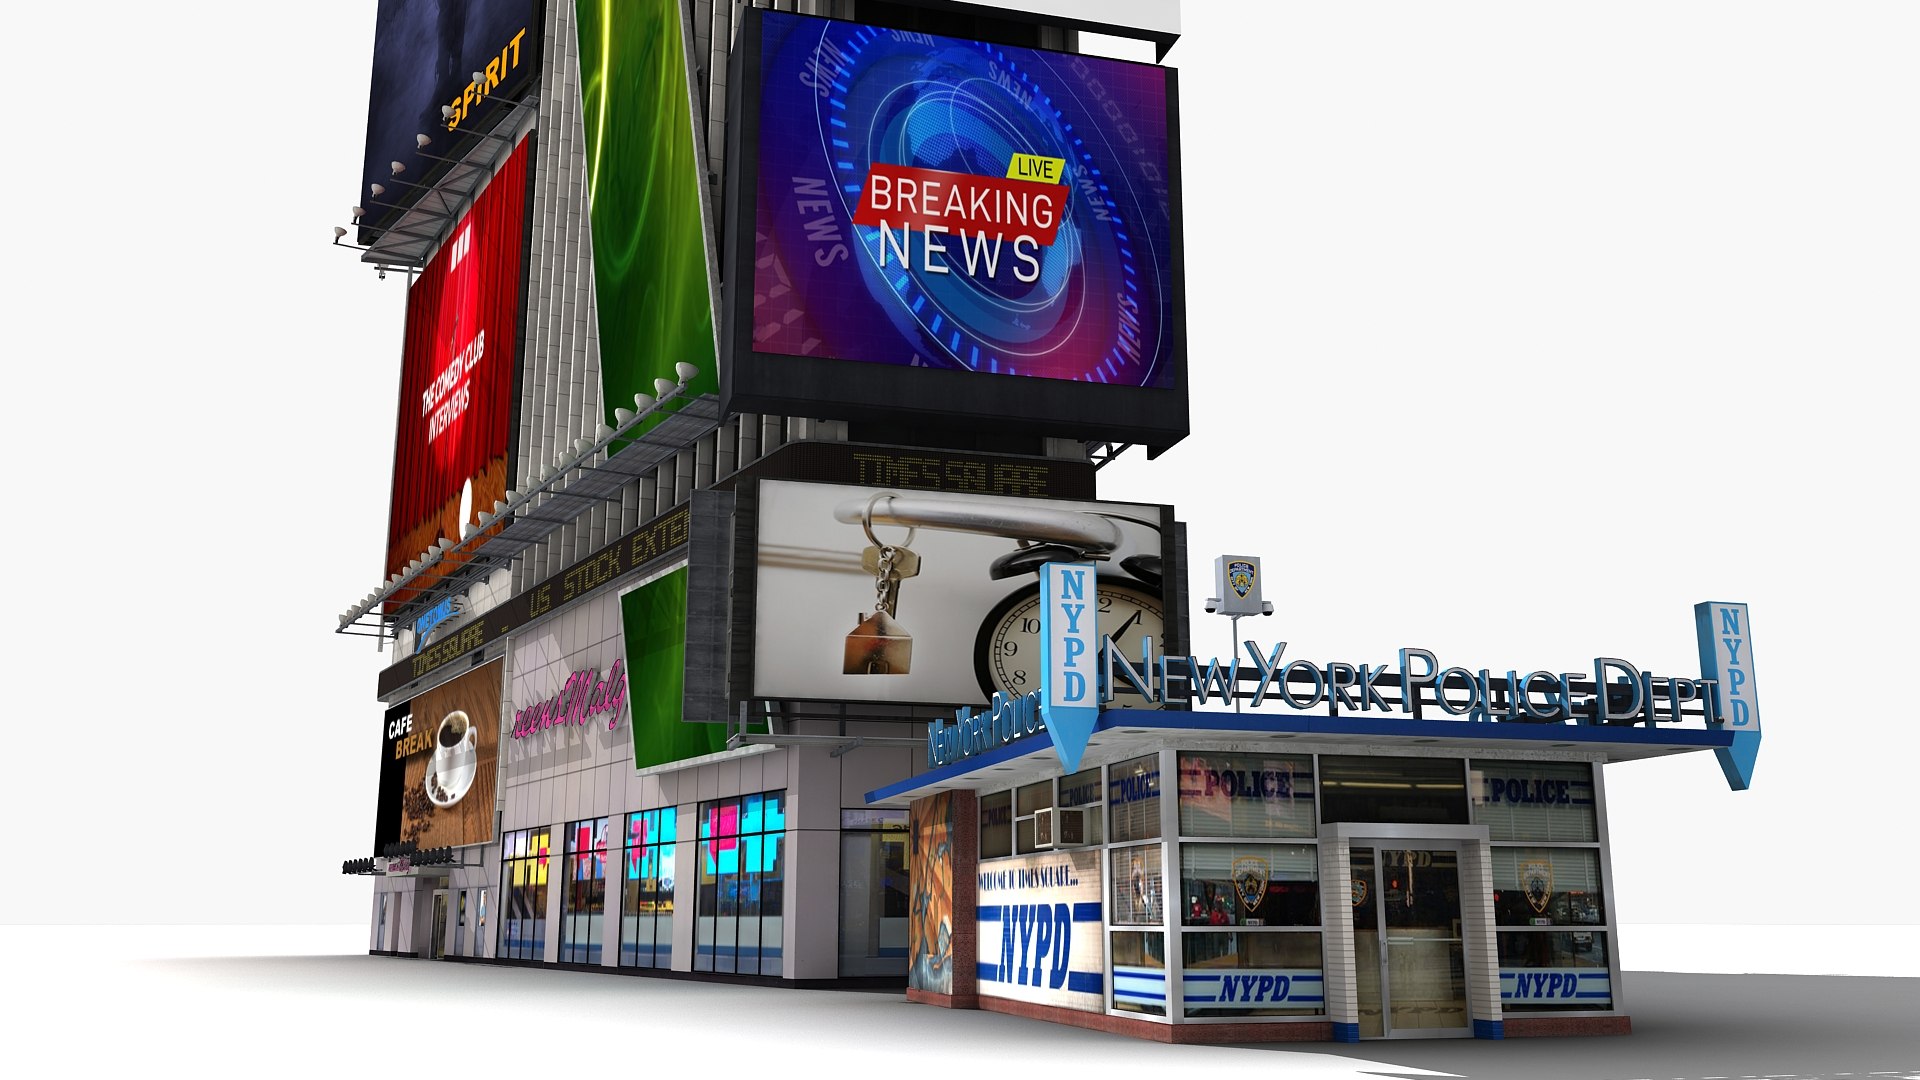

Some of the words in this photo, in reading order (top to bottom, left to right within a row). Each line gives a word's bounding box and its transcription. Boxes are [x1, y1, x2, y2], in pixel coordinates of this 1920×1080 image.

[448, 27, 526, 132] SPIRIT
[988, 60, 1032, 110] NEWS
[1018, 157, 1054, 179] LIVE
[1073, 164, 1112, 222] NEWS
[792, 176, 849, 267] NEWS
[871, 174, 1053, 229] BREAKING
[879, 218, 1040, 282] NEWS
[1117, 292, 1141, 366] NEWS
[422, 381, 436, 418] THE
[435, 349, 466, 404] COMEDY
[465, 328, 485, 374] CLUB
[428, 378, 471, 445] INTERVIEWS
[854, 453, 940, 489] TIMES
[530, 584, 551, 618] US
[563, 544, 622, 601] STOCK
[1003, 641, 1018, 657] 9
[1061, 569, 1086, 702] NYPD
[1012, 670, 1027, 685] 8
[1399, 648, 1587, 719] POLICE
[1720, 608, 1750, 727] NYPD
[388, 713, 413, 740] CAFE
[395, 727, 433, 760] BREAK
[1069, 783, 1095, 808] POLICE
[1120, 773, 1152, 802] POLICE
[1204, 769, 1291, 799] POLICE
[1492, 777, 1570, 804] POLICE
[978, 871, 1006, 891] WELCOME
[1018, 866, 1039, 889] TIMES
[998, 903, 1071, 990] NYPD
[1219, 974, 1290, 1003] NYPD
[1515, 972, 1577, 999] NYPD
